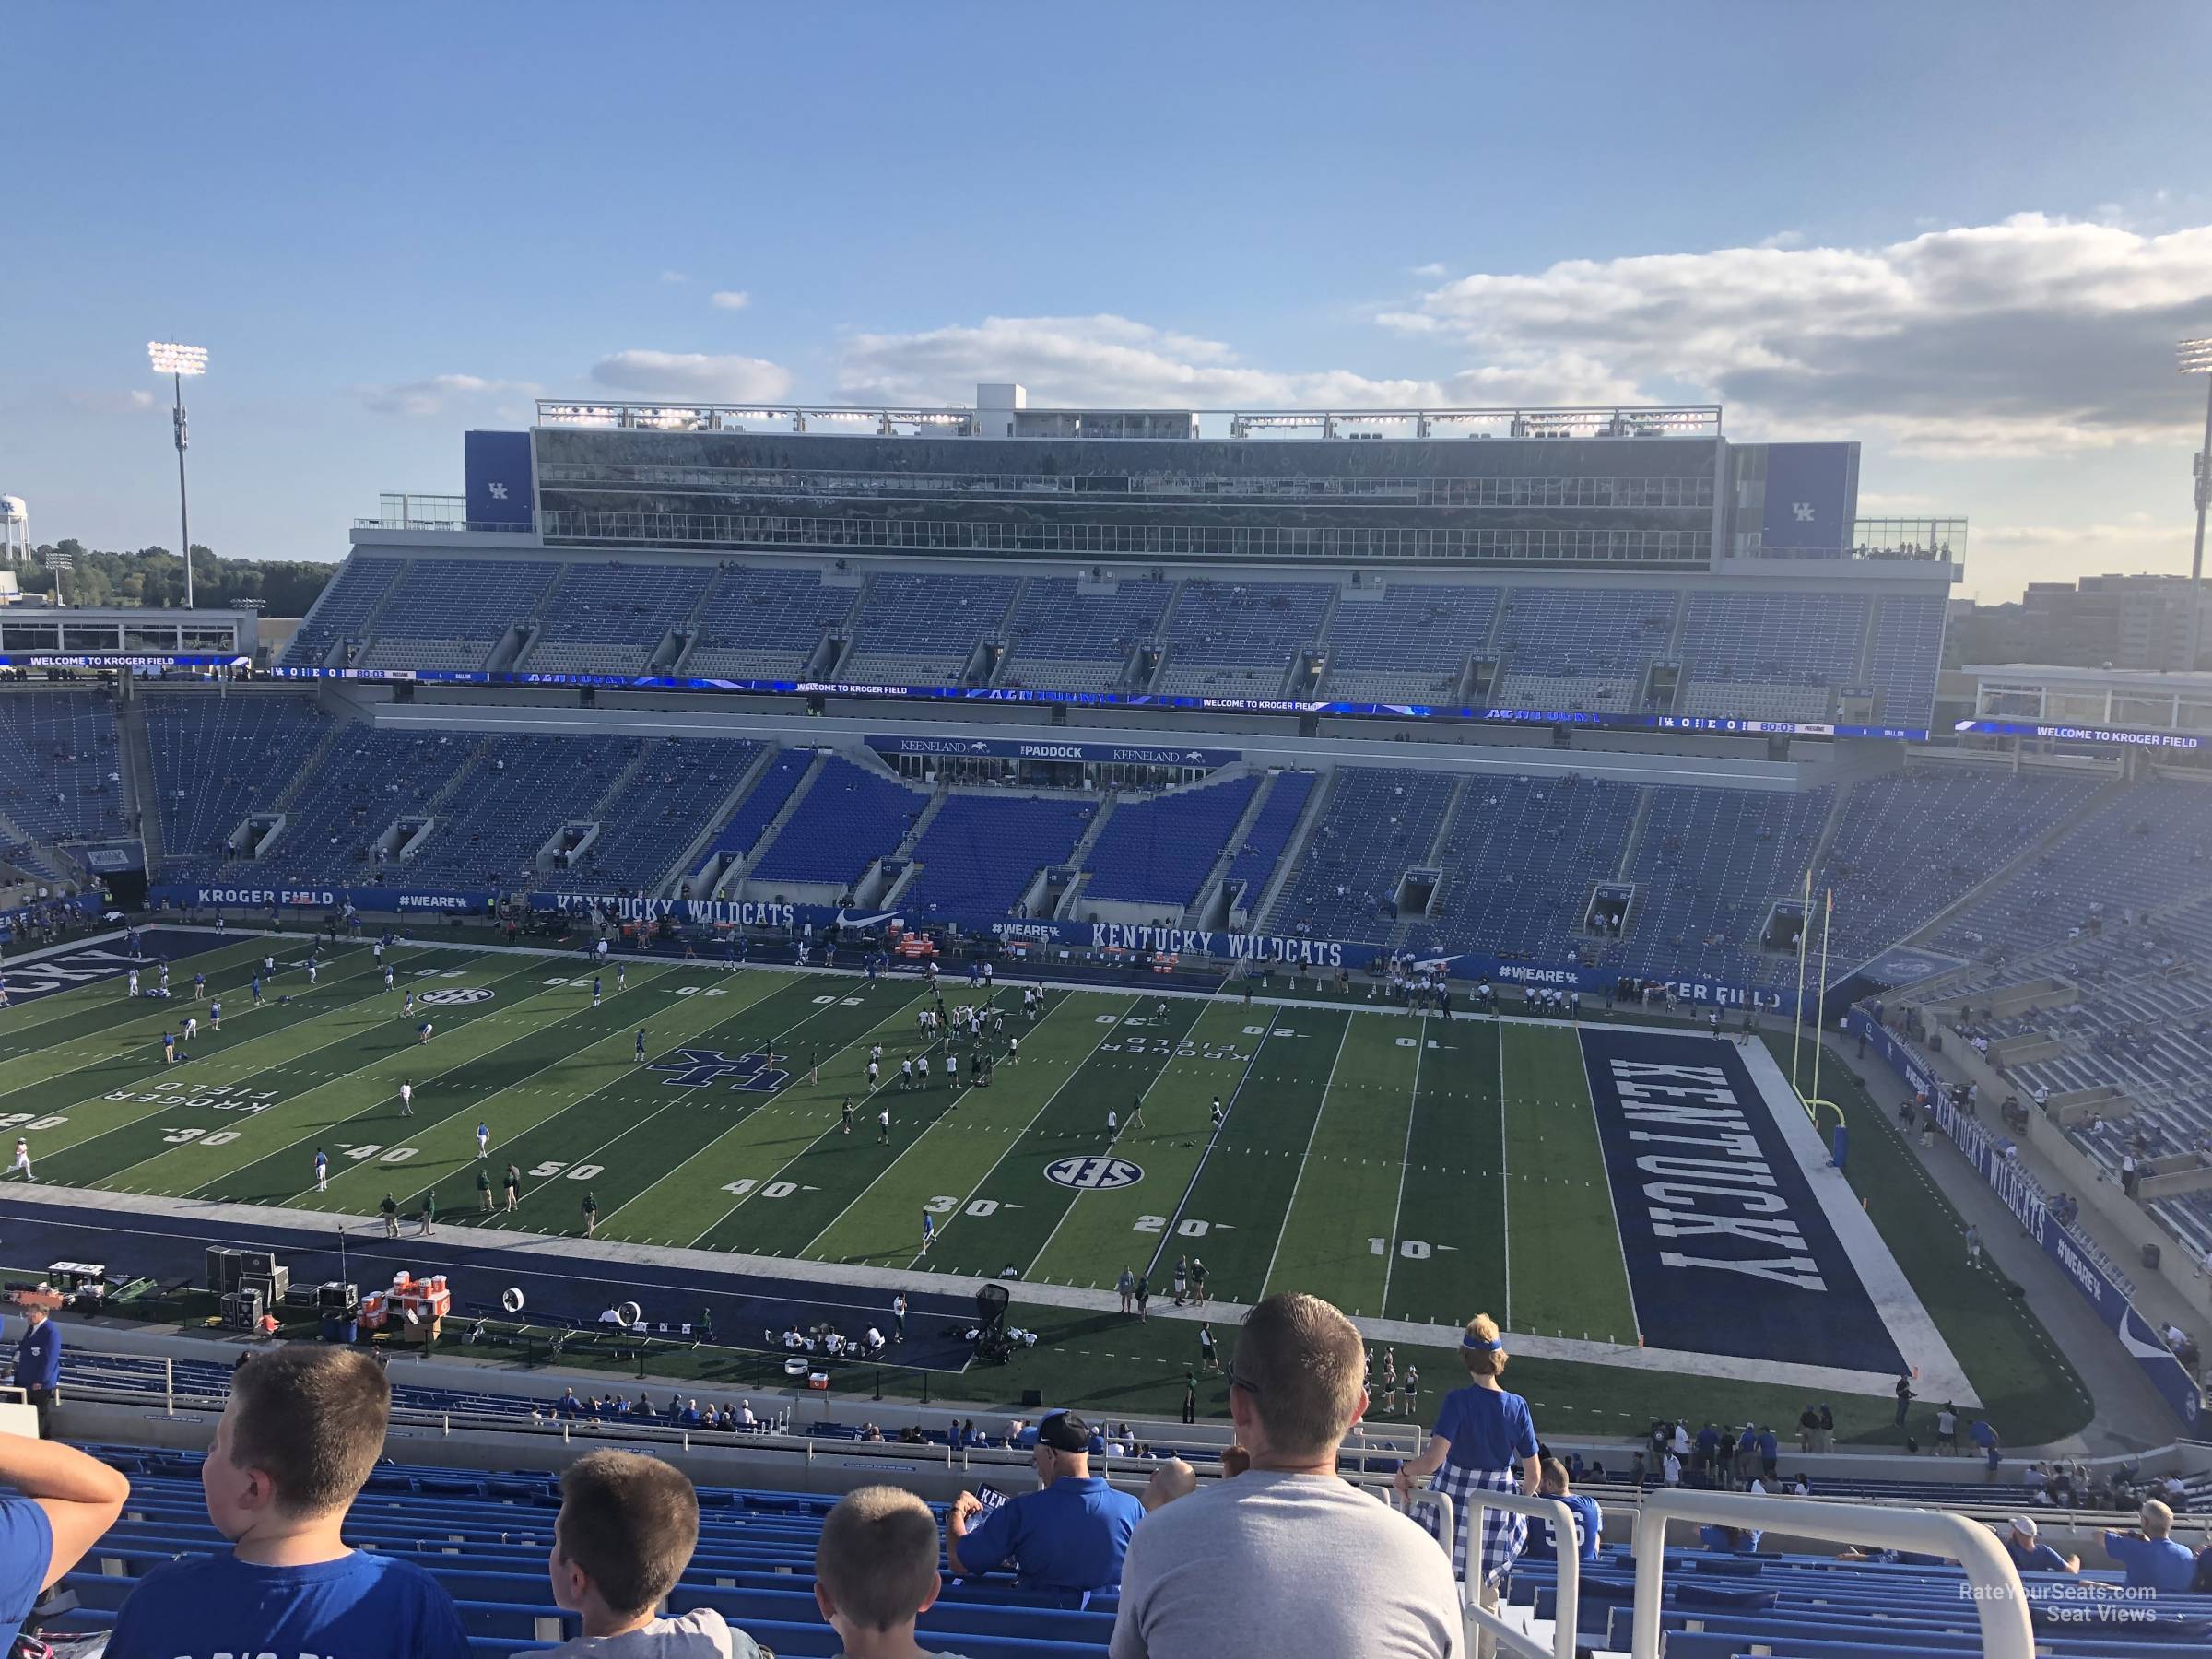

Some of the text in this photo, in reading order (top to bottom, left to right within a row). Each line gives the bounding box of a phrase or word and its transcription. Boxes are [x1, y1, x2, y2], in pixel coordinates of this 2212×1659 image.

[30, 656, 174, 665] WELCOME TO KROGER FIELD
[797, 683, 907, 695] WELCOME TO KROGER FIELD
[1203, 699, 1244, 708] WELCOME
[1259, 700, 1293, 710] KROGER
[1295, 702, 1318, 712] FIELD
[1760, 723, 1796, 732] 80:03
[900, 740, 967, 753] KEENELAND
[2037, 726, 2198, 749] WELCOME TO KROGER FIELD
[1025, 745, 1082, 758] PADDOCK
[1113, 749, 1180, 762] KEENELAND
[198, 889, 334, 905] KROGER FIELD
[688, 900, 794, 926] WILDCATS
[1092, 923, 1342, 967] KENTUCKY WILDCATS
[675, 986, 729, 996] 40
[811, 995, 865, 1006] 50
[1094, 1015, 1147, 1026] 30
[1241, 1025, 1295, 1037] 20
[1100, 1042, 1253, 1062] KROGER
[1125, 1037, 1237, 1052] FIELD
[1395, 1037, 1440, 1049] 10
[154, 1082, 280, 1099] FIELD
[103, 1089, 273, 1112] KROGER
[163, 1128, 242, 1146] 30
[342, 1144, 420, 1162] 40
[527, 1160, 606, 1181] 50
[1051, 1158, 1136, 1188] SEC
[1609, 1058, 1828, 1293] KENTUCKY
[1936, 1088, 2047, 1245] KENTUCKY WILDCATS
[720, 1178, 799, 1198] 40
[923, 1195, 1001, 1217] 30
[1133, 1215, 1211, 1237] 20
[1367, 1237, 1431, 1260] 10
[981, 1488, 1006, 1509] KEN
